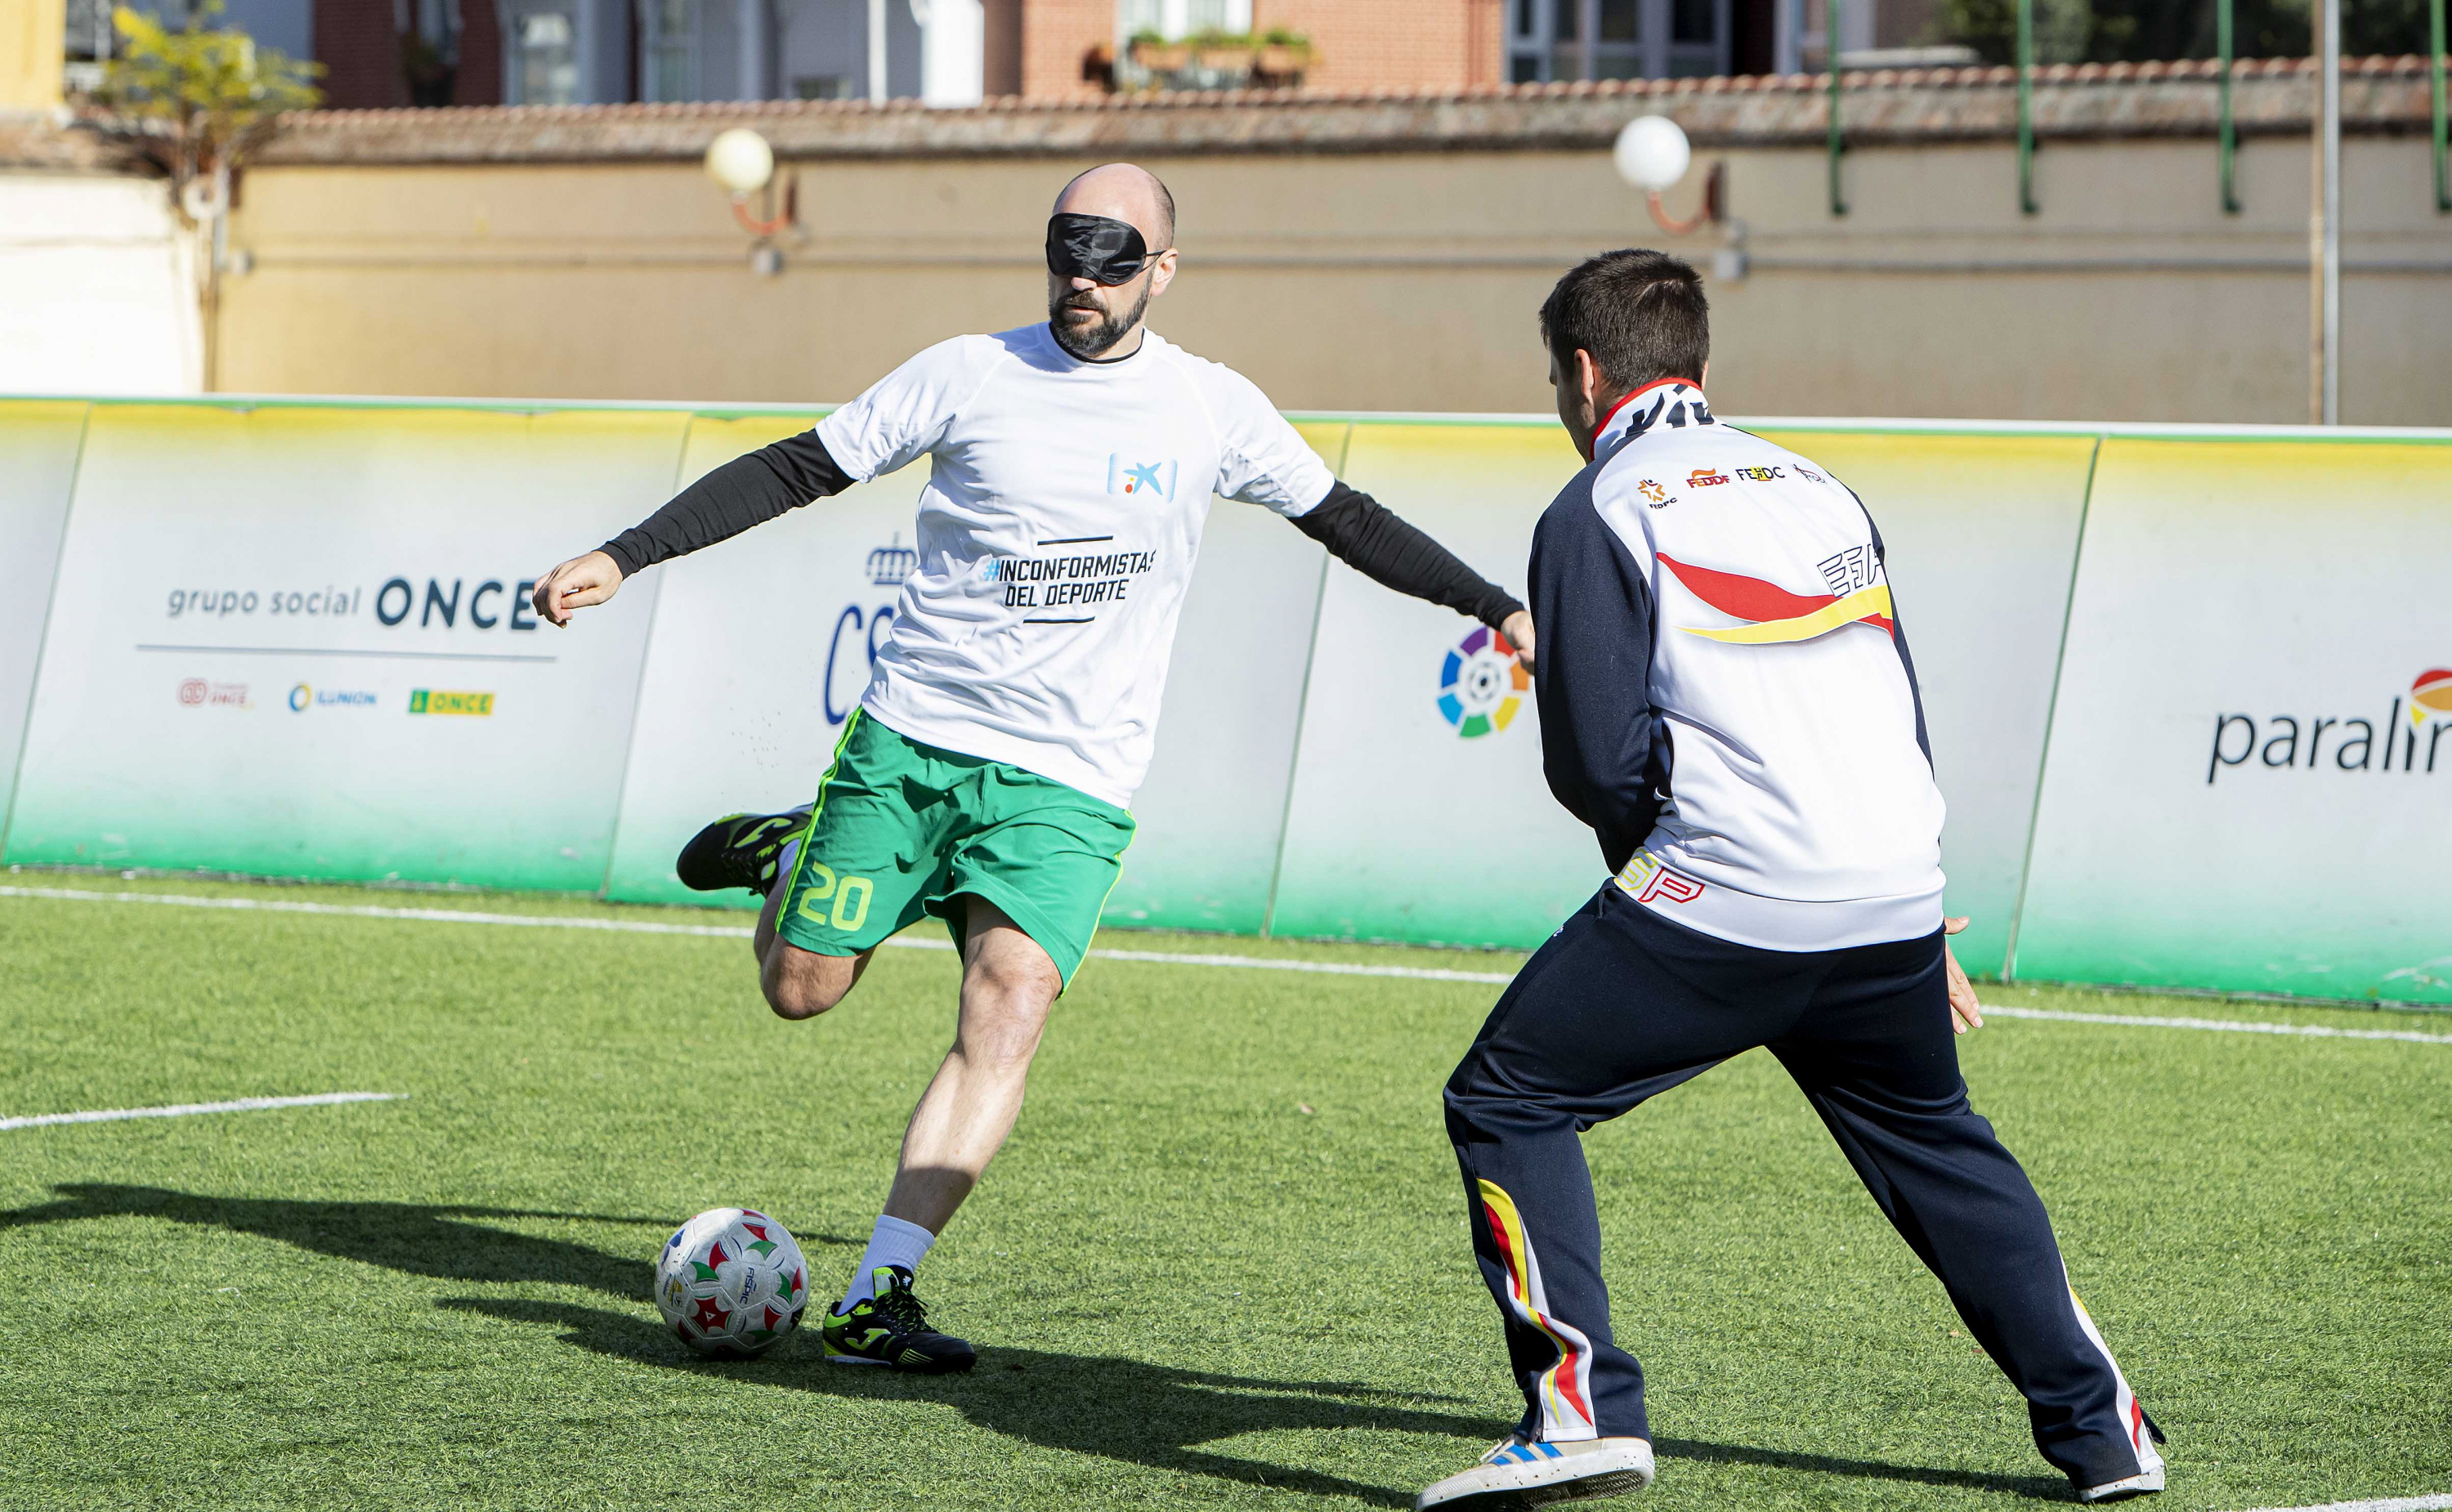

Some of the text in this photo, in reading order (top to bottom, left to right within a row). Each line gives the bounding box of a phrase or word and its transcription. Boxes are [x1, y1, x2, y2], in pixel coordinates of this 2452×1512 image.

[983, 549, 1157, 582] #INCONFORMISTAS
[167, 579, 539, 629] grupo social ONCE
[1005, 579, 1130, 607] DEL DEPORTE
[434, 693, 490, 712] ONCE
[798, 861, 874, 931] 20
[740, 1267, 754, 1304] FISPIC
